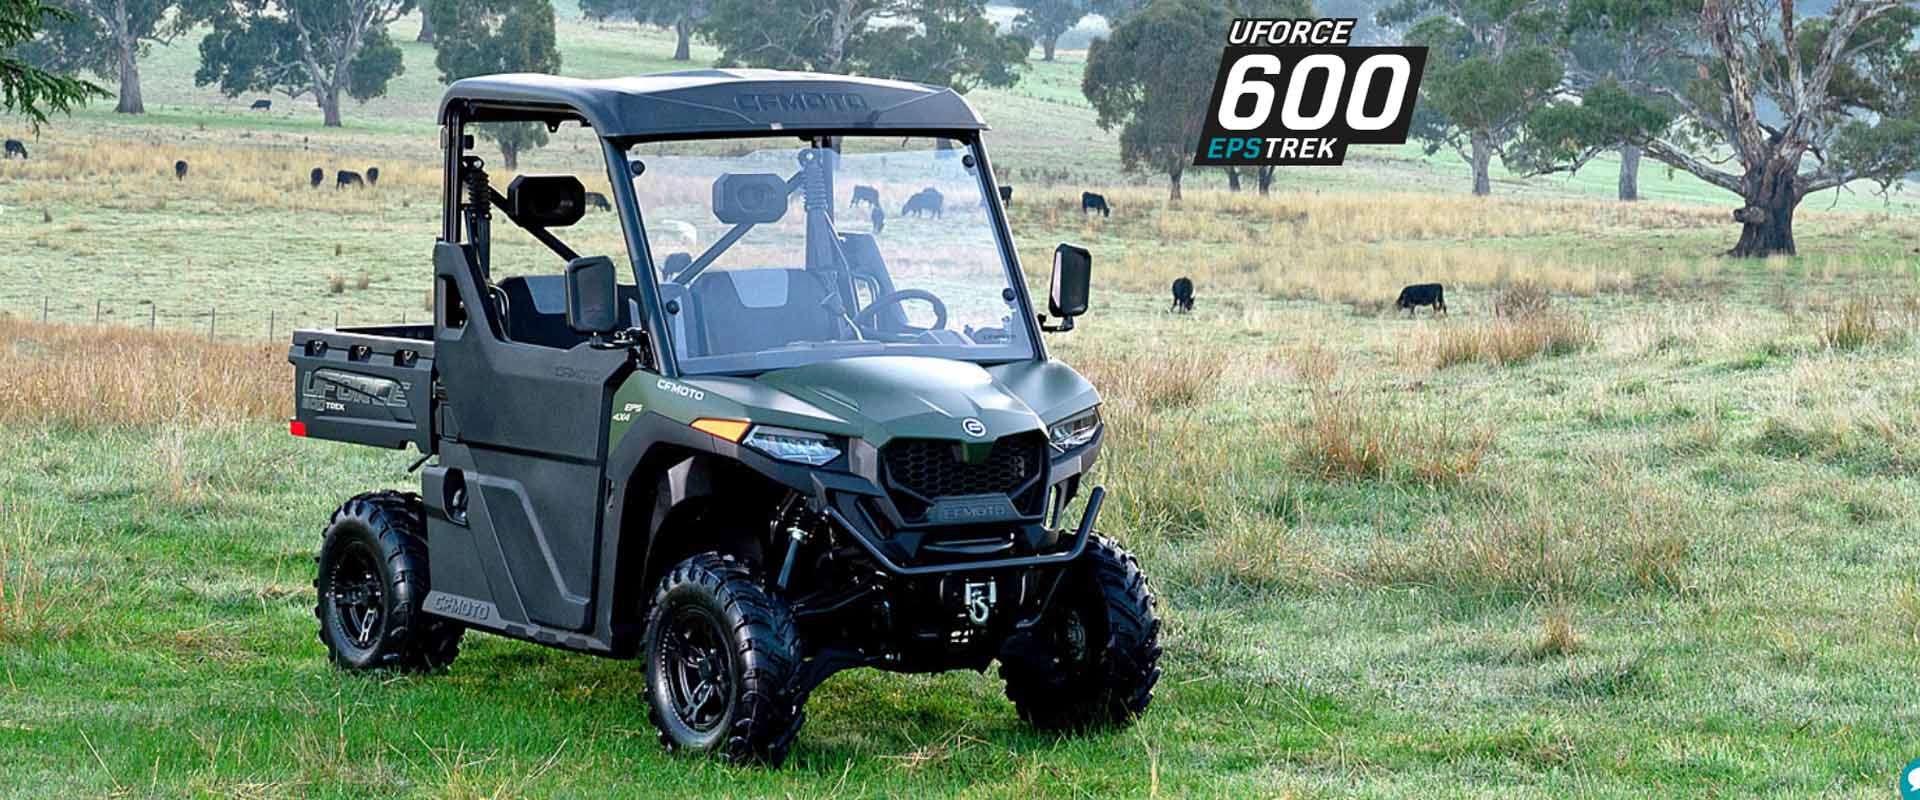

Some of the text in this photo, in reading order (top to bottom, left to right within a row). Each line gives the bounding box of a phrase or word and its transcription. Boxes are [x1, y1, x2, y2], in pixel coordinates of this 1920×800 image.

[656, 379, 704, 400] CFMOTO
[624, 403, 643, 412] EPS
[435, 595, 490, 620] CFMOTO
